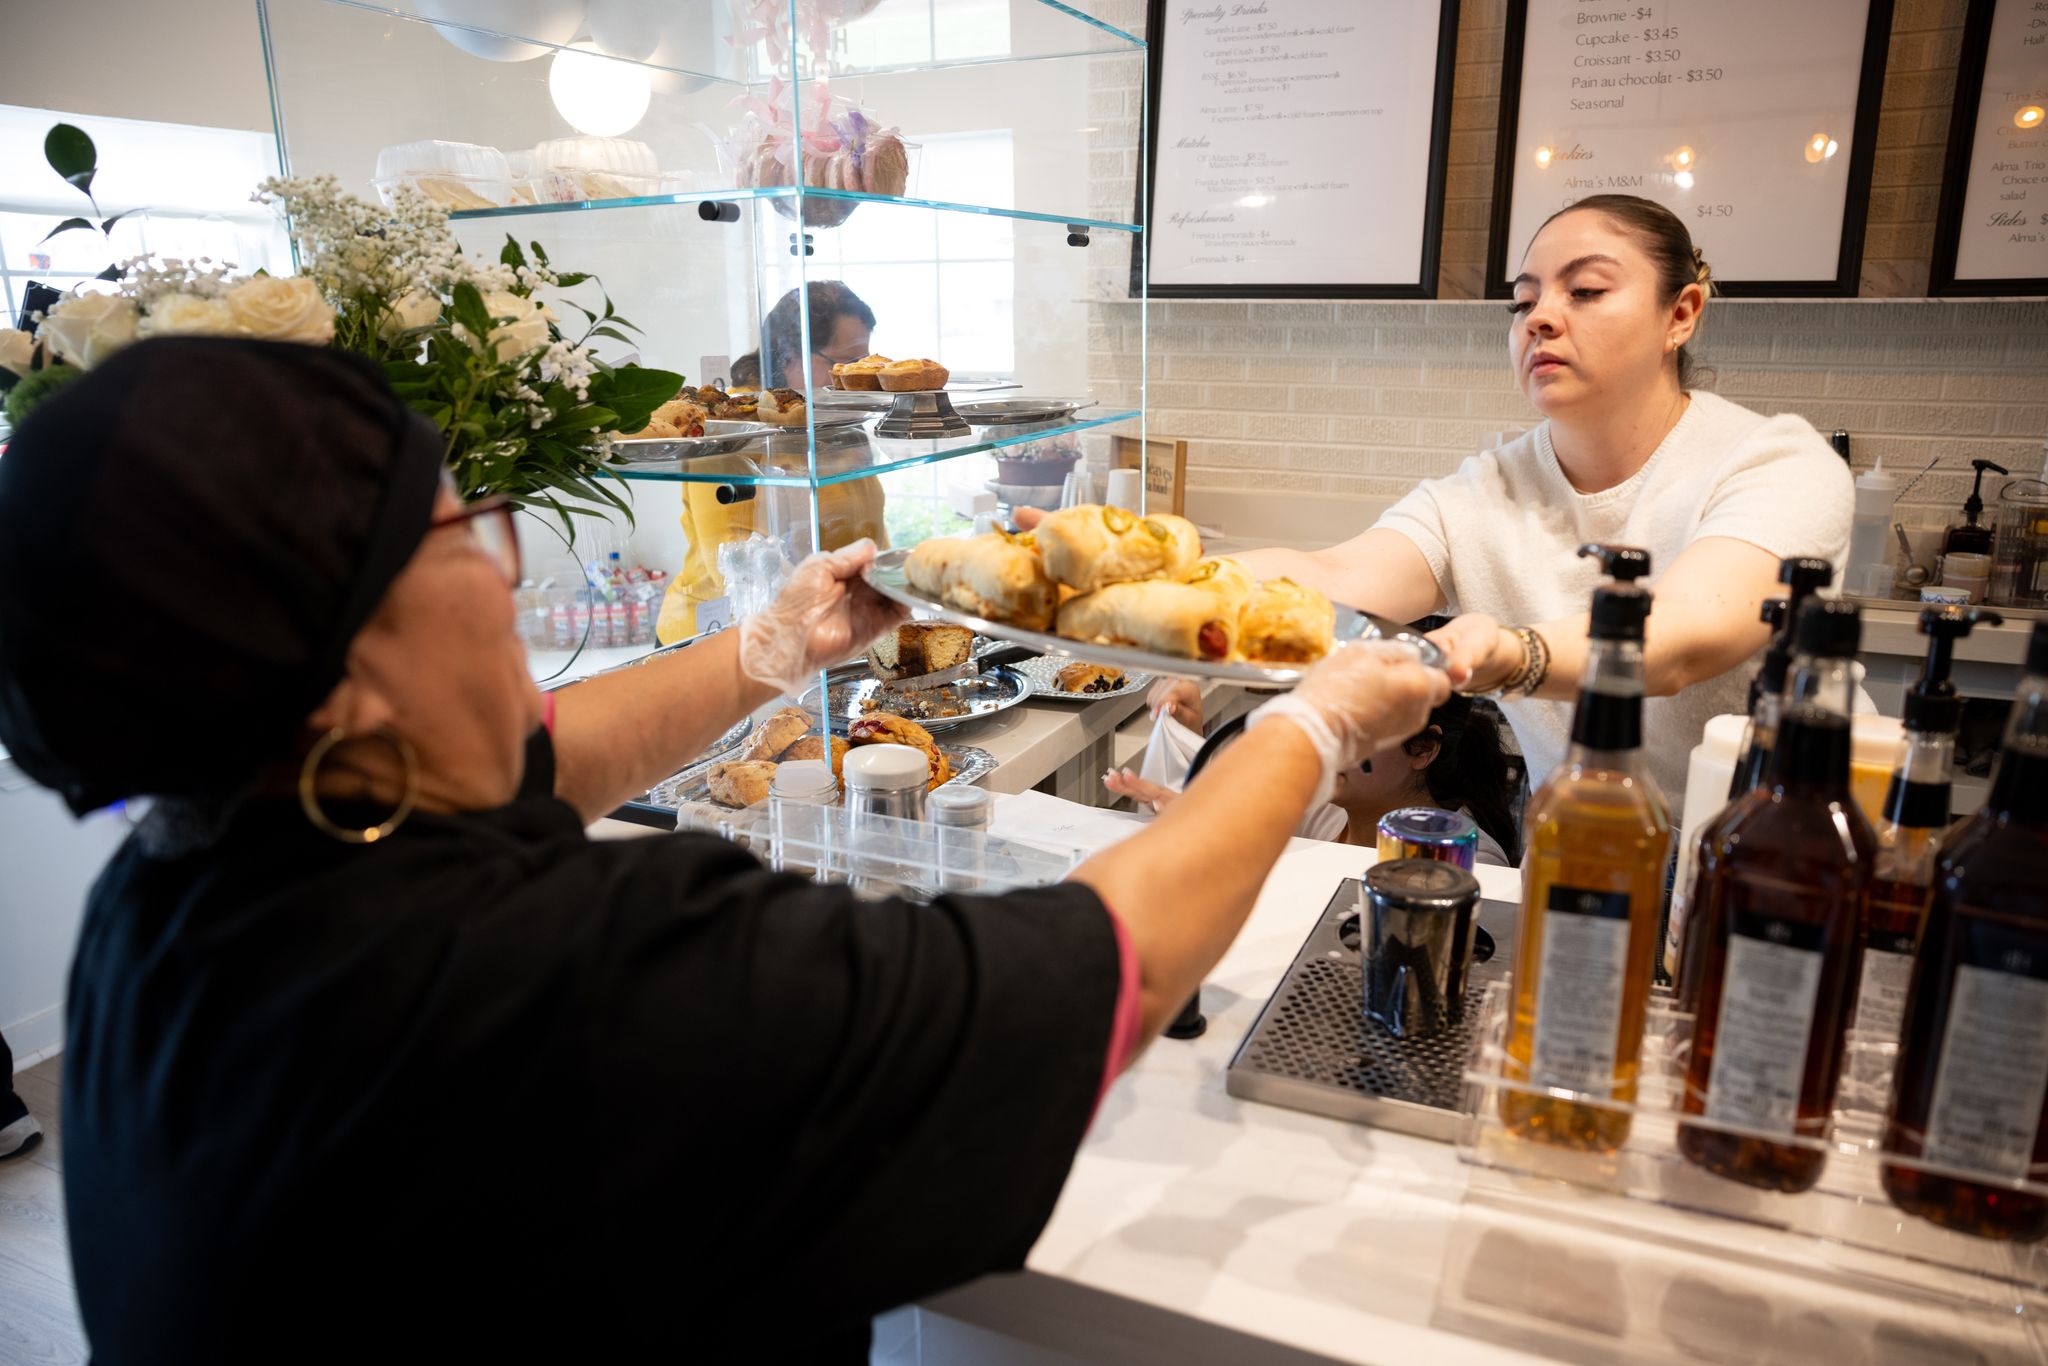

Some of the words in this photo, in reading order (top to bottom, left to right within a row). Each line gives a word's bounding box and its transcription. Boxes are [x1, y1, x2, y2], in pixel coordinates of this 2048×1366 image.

[1180, 4, 1226, 24] Specialty
[1230, 1, 1268, 17] Drinks
[1577, 11, 1627, 25] Brownie
[1575, 29, 1630, 48] Cupcake
[1643, 26, 1679, 42] $3.45
[1574, 54, 1631, 68] Croissant
[1645, 49, 1681, 64] $3.50
[1571, 75, 1598, 89] Pain
[1601, 77, 1616, 88] au
[1618, 71, 1672, 87] chocolat
[1686, 67, 1723, 83] $3.50
[1570, 95, 1625, 111] Seasonal
[1991, 161, 2019, 172] Alma
[2023, 159, 2046, 170] Trio
[1563, 176, 1604, 189] Alma's
[1606, 175, 1643, 188] M&M
[2002, 175, 2040, 186] Choice
[2000, 189, 2026, 201] salad
[1697, 204, 1733, 218] $4.50
[1986, 210, 2028, 227] Sides
[1166, 210, 1235, 229] Refreshments
[2009, 231, 2046, 243] Alma's
